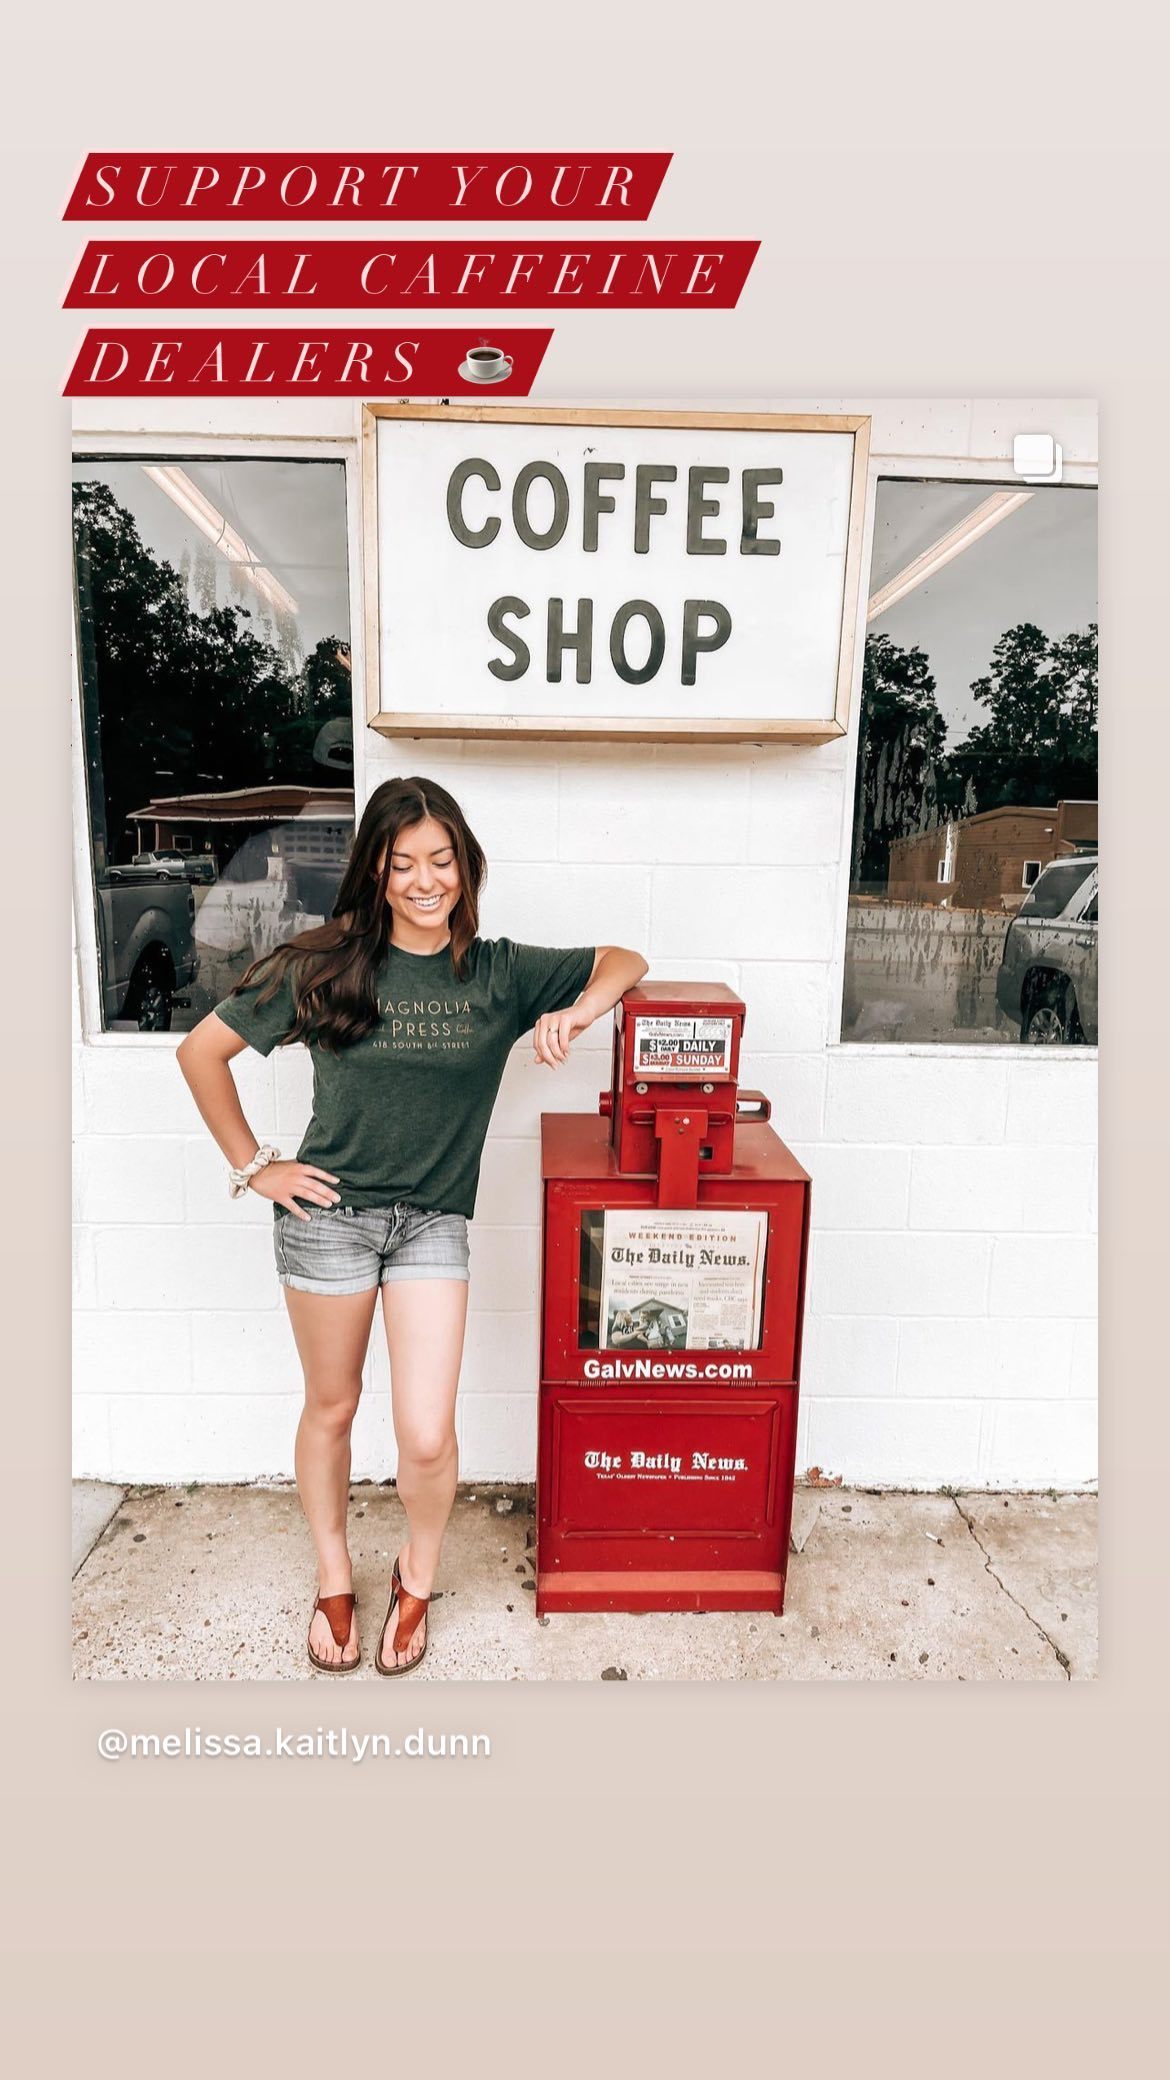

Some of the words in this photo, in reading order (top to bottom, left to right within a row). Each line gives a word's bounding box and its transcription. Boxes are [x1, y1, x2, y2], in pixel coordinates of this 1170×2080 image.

[446, 457, 783, 556] COFFEE
[487, 595, 732, 686] SHOP
[392, 1019, 451, 1037] PRESS
[392, 1041, 423, 1049] SOUTH
[683, 1040, 716, 1052] DAILY
[676, 1054, 722, 1066] SUNDAY
[628, 1232, 683, 1240] WEEKEND
[689, 1233, 737, 1242] EDITION
[611, 1247, 644, 1266] The
[648, 1247, 695, 1268] Daily
[699, 1250, 750, 1266] News.
[583, 1359, 752, 1379] GalvNews.com
[584, 1450, 622, 1472] The
[630, 1451, 682, 1473] Daily
[692, 1452, 749, 1471] News.
